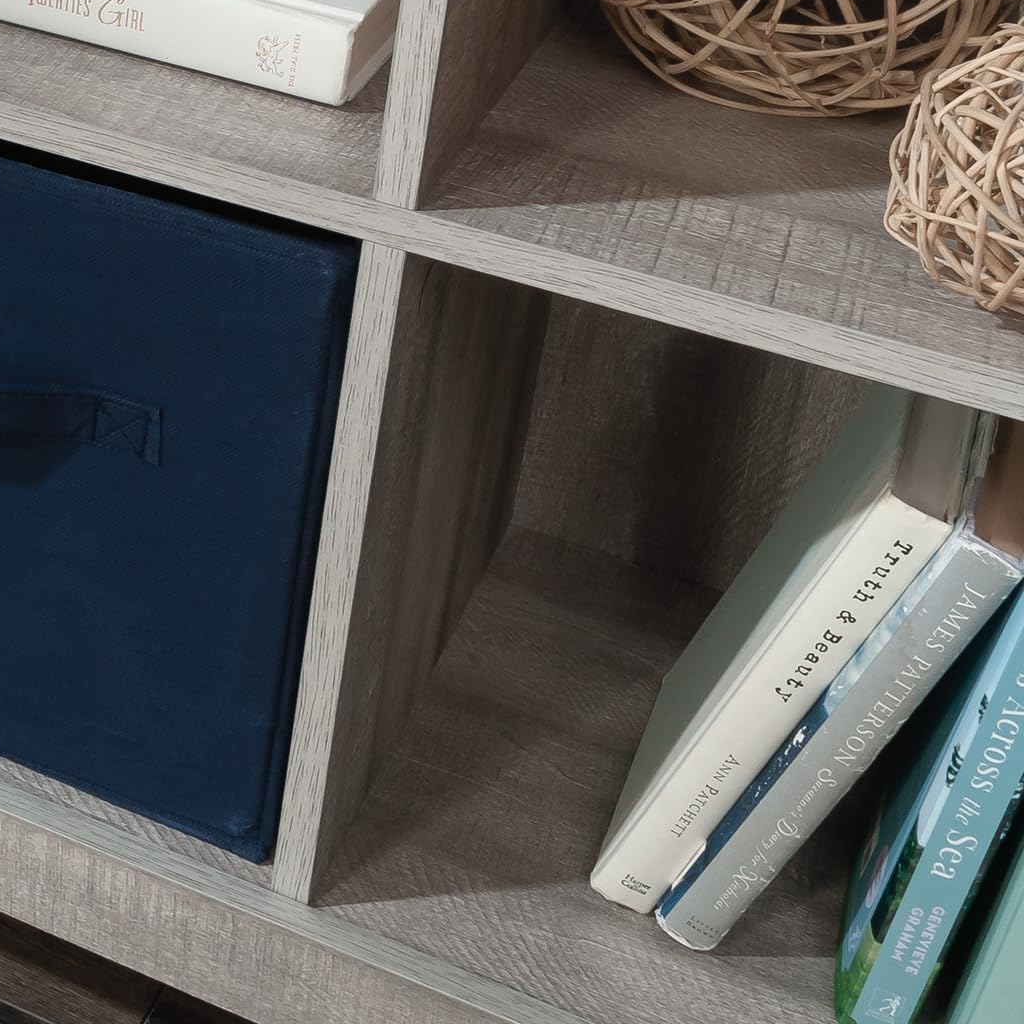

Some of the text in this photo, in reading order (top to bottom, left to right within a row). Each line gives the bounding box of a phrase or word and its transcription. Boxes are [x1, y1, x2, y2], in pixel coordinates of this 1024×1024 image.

[774, 539, 914, 704] Truth & Beauty
[925, 581, 986, 653] JAMES
[832, 655, 933, 768] PATTERSON
[670, 753, 741, 839] ANN PATCHETT
[955, 796, 982, 827] the
[751, 847, 769, 867] for
[761, 816, 800, 854] Diary
[930, 828, 978, 880] Sea
[713, 864, 759, 912] Nicholas
[891, 906, 925, 962] GRAHAM
[905, 905, 946, 976] GENEVIEVE
